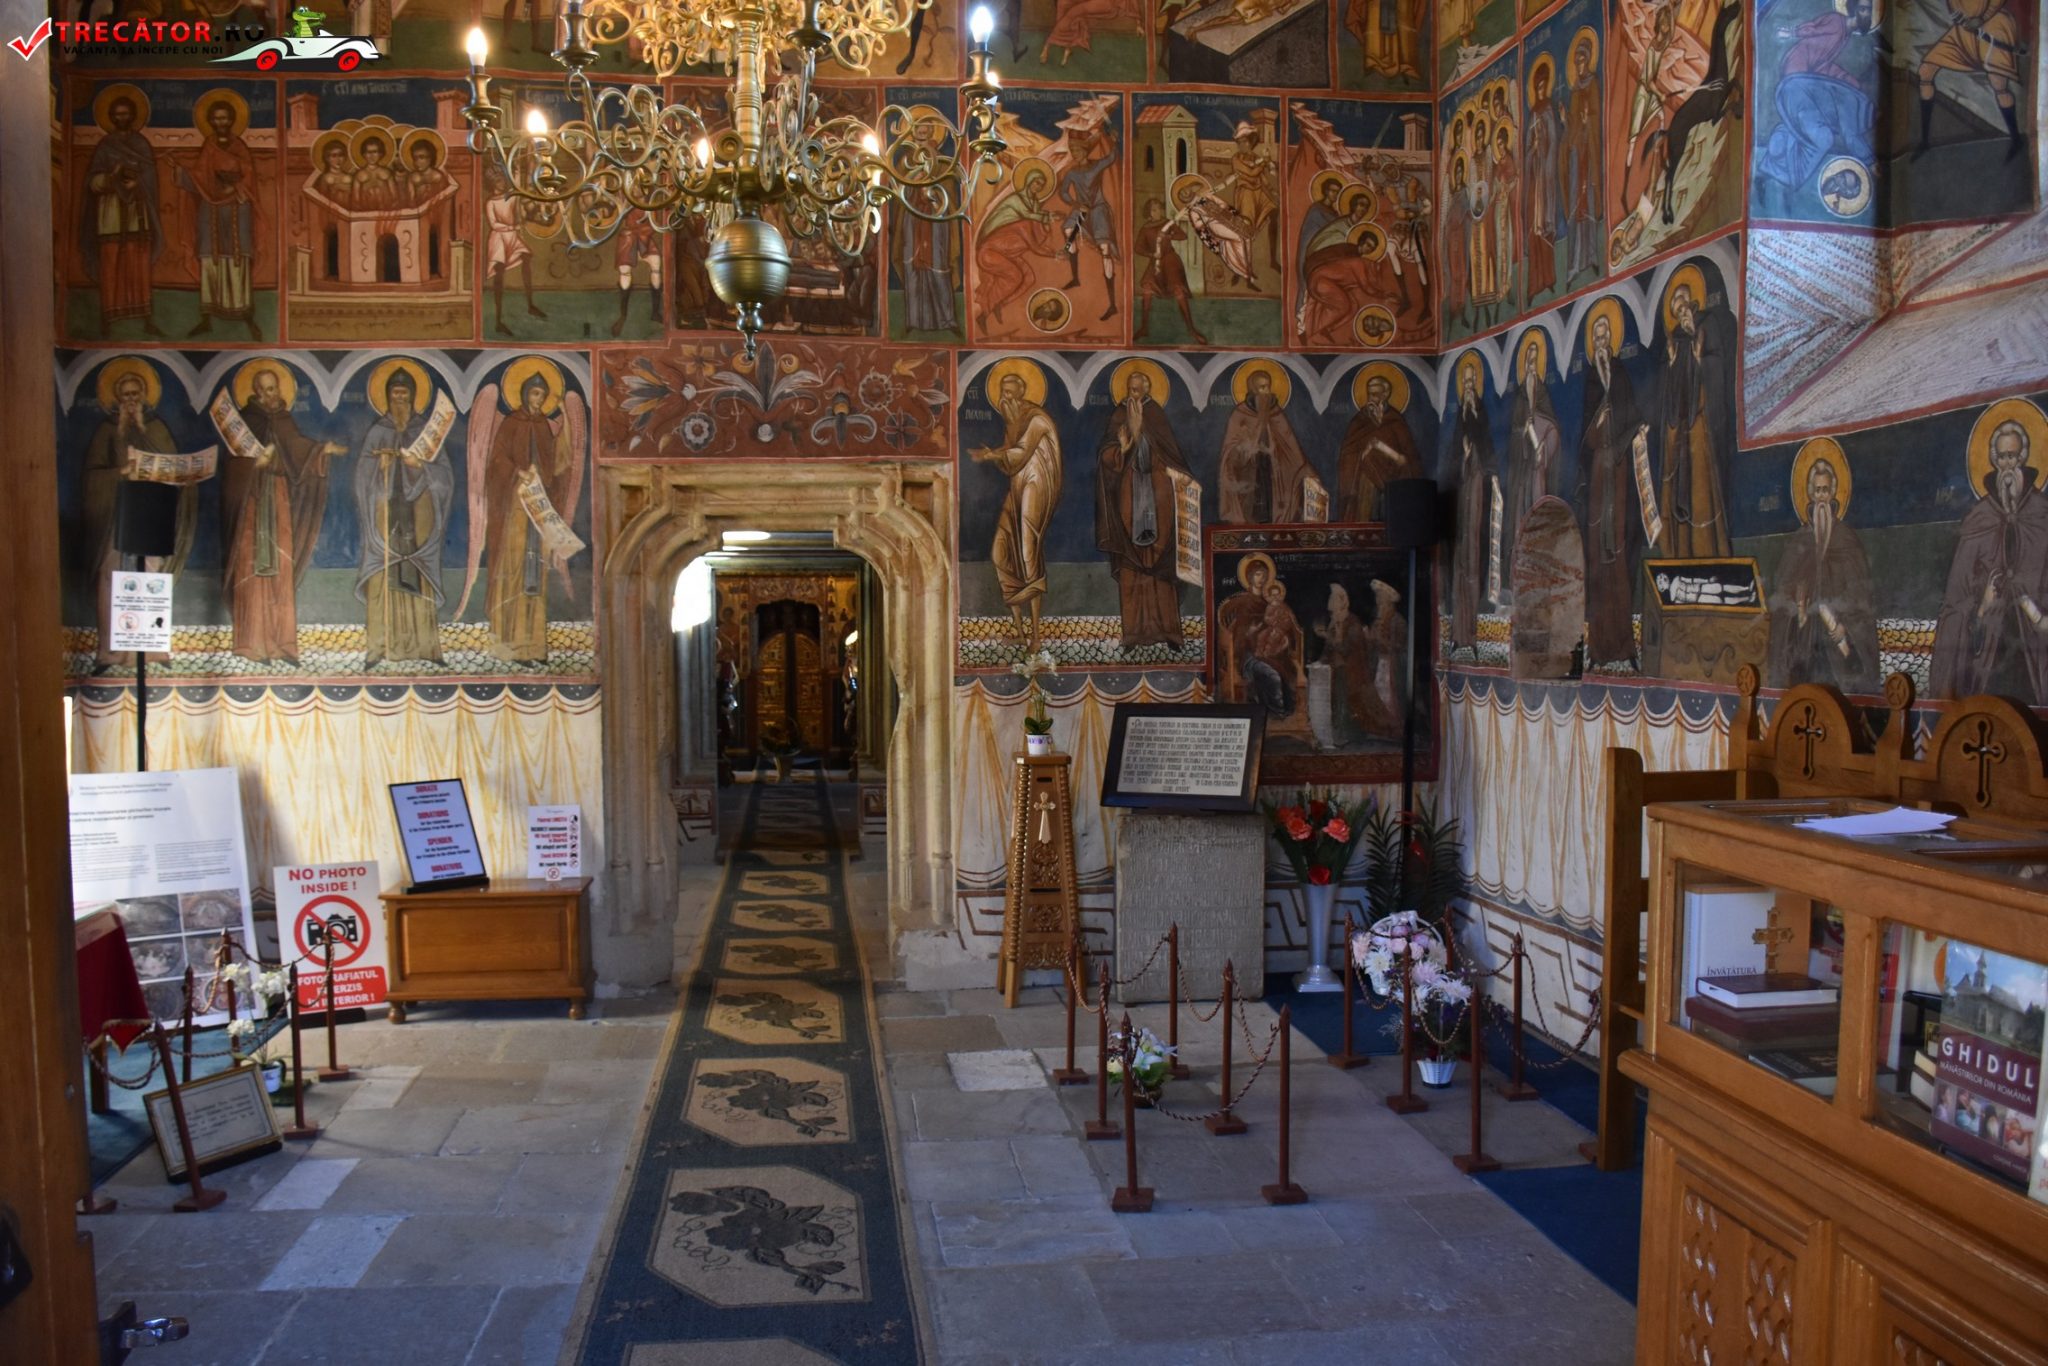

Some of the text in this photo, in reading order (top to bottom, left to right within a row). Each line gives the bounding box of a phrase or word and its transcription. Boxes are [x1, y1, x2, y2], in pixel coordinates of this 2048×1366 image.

[288, 866, 367, 881] NO PHOTO
[301, 882, 348, 894] INSIDE
[1942, 1037, 2034, 1088] GHIDUL
[1984, 1078, 1996, 1090] DIN
[1997, 1084, 2032, 1105] ROMÂNIA
